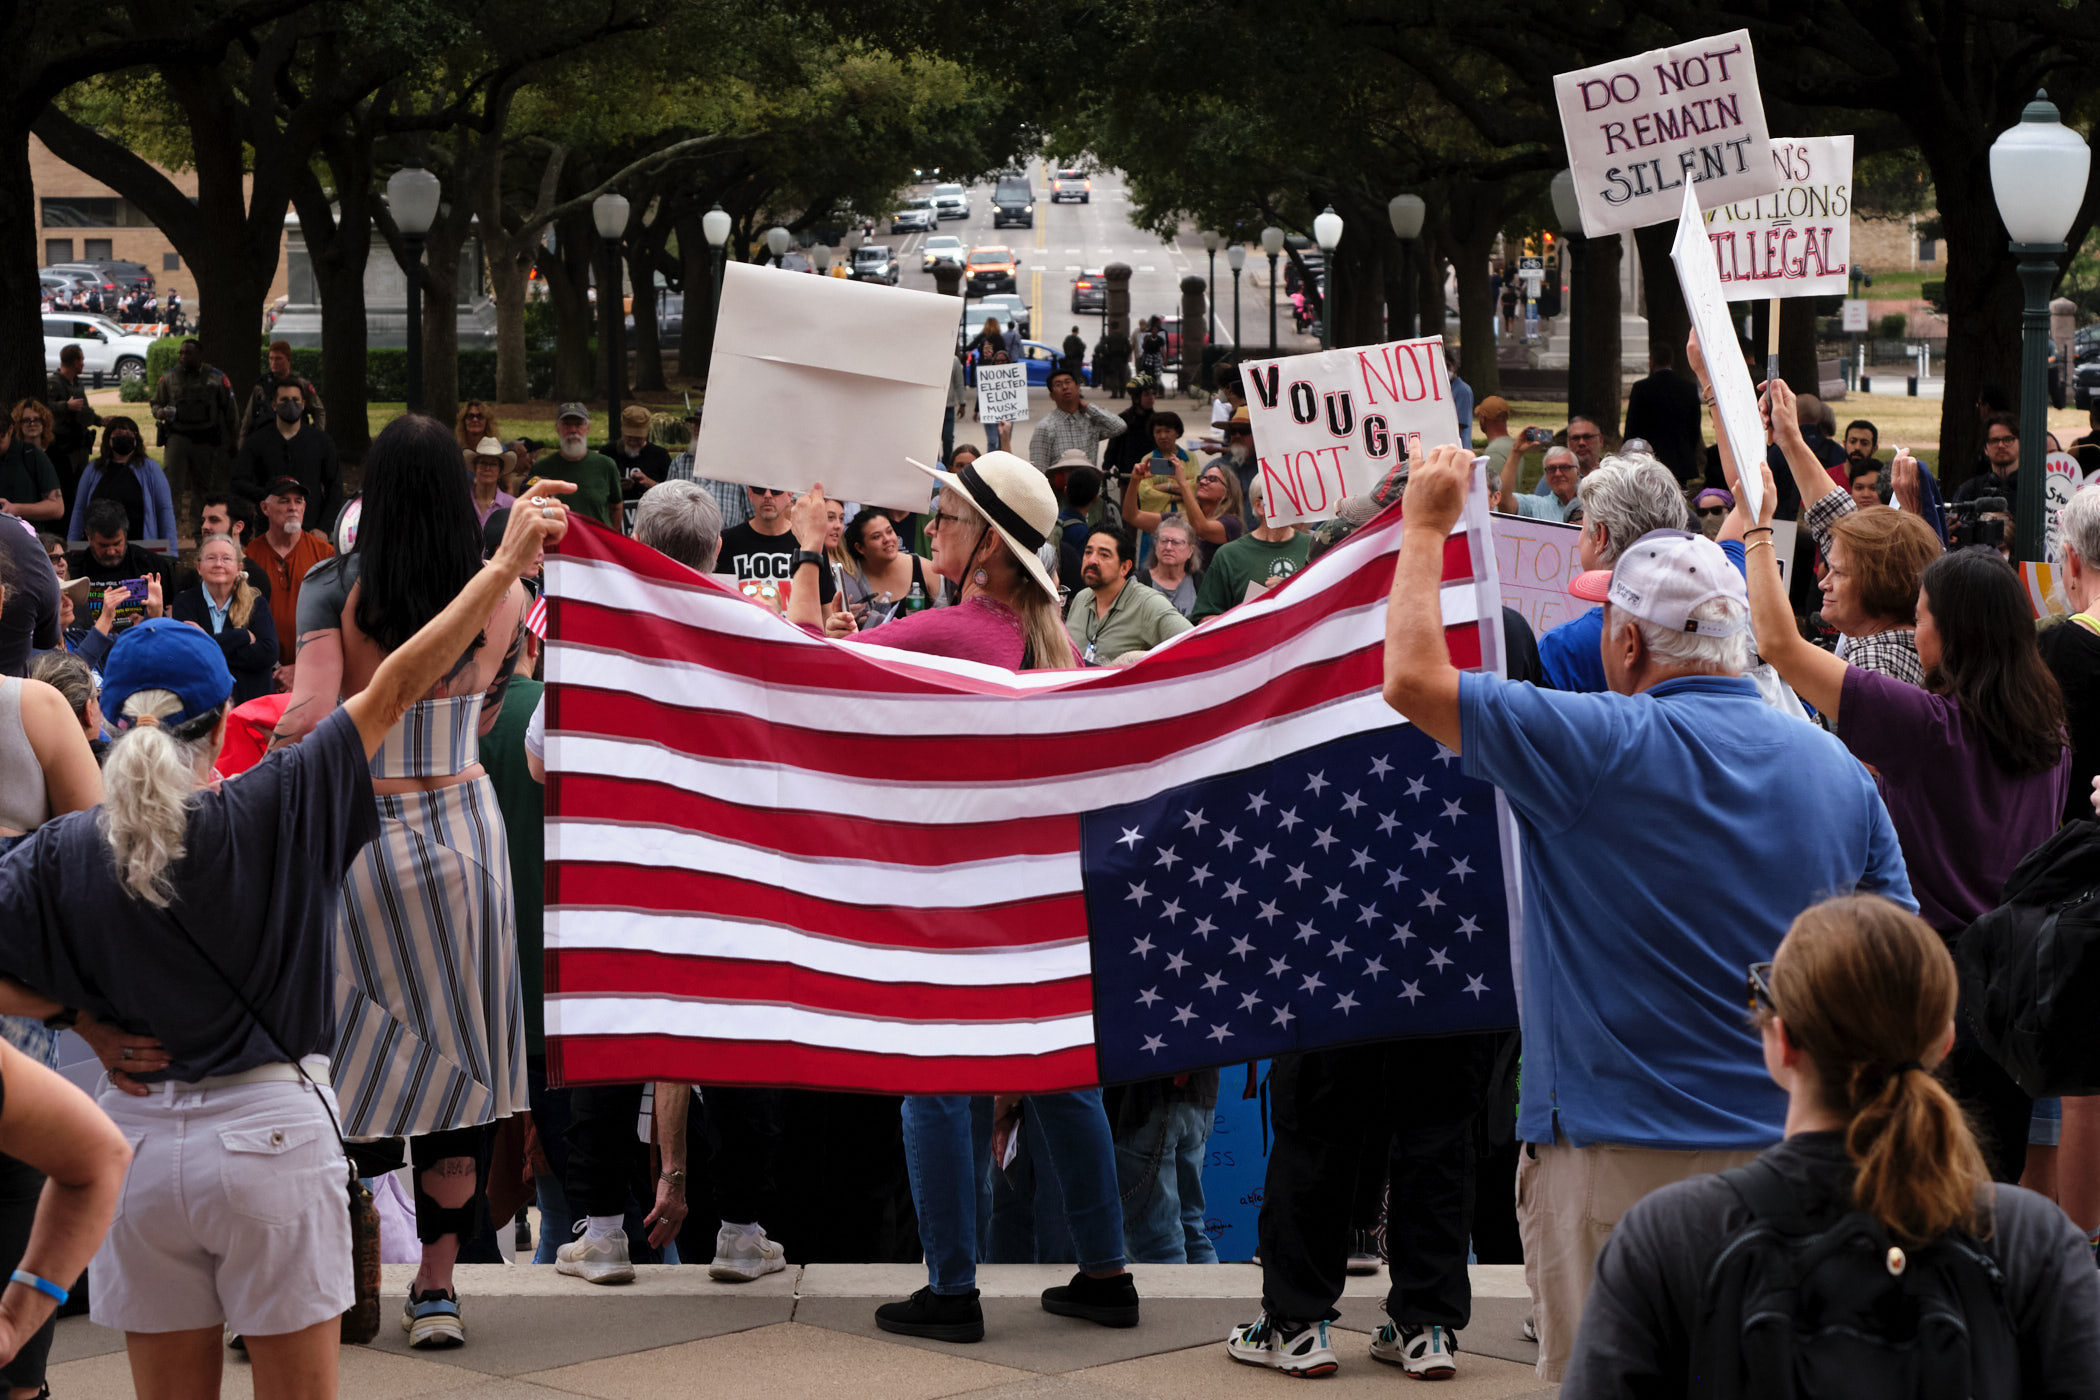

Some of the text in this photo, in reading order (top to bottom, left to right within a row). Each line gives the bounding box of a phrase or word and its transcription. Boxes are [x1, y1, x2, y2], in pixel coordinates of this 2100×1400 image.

[1577, 43, 1742, 112] DO NOT
[1600, 92, 1743, 155] REMAIN
[1600, 133, 1753, 207] SILENT
[1708, 226, 1847, 283] ILLEGAL
[981, 380, 1025, 391] ELECTED
[987, 390, 1016, 403] ELON
[1357, 340, 1443, 405] NOT
[987, 402, 1018, 413] MUSK
[1258, 445, 1349, 518] NOT
[733, 552, 794, 581] LOC
[1496, 533, 1580, 584] TOP
